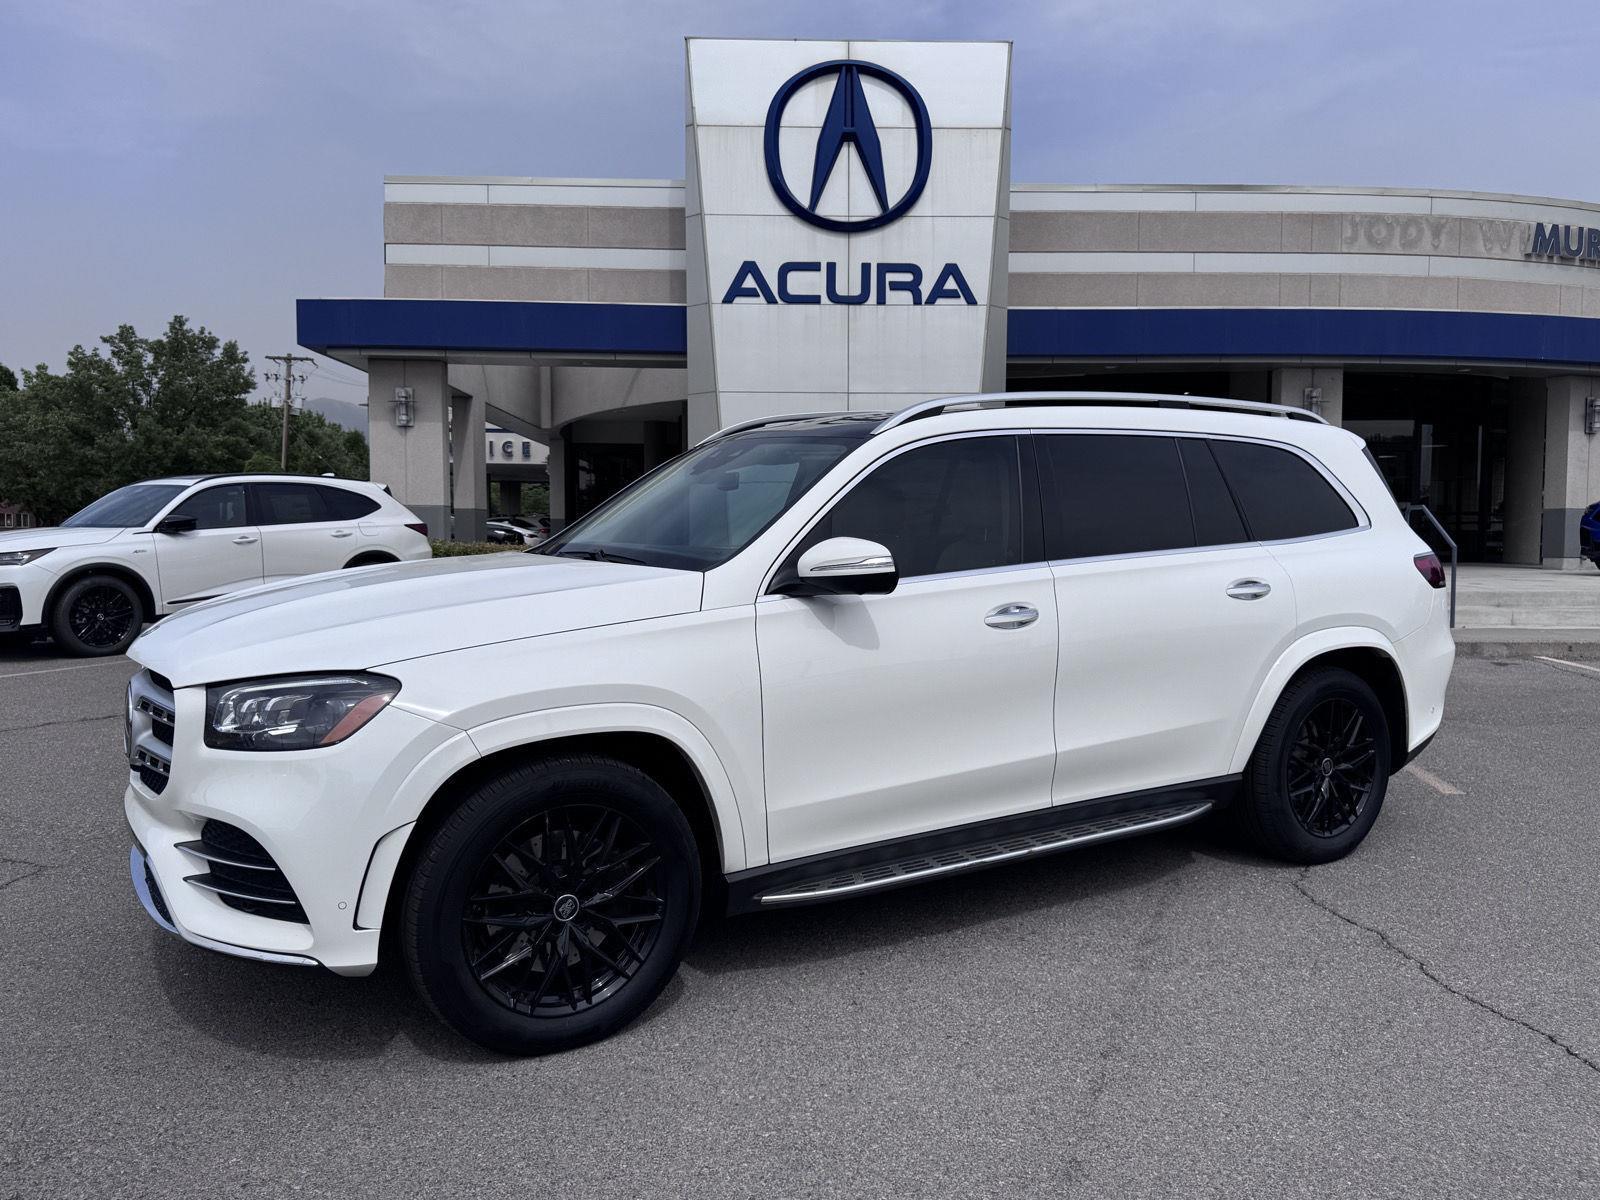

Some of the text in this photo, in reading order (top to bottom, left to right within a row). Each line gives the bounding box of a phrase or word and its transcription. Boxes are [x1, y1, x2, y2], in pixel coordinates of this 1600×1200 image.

[1531, 222, 1600, 258] MUR
[721, 260, 978, 305] ACURA
[489, 440, 531, 457] ICE
